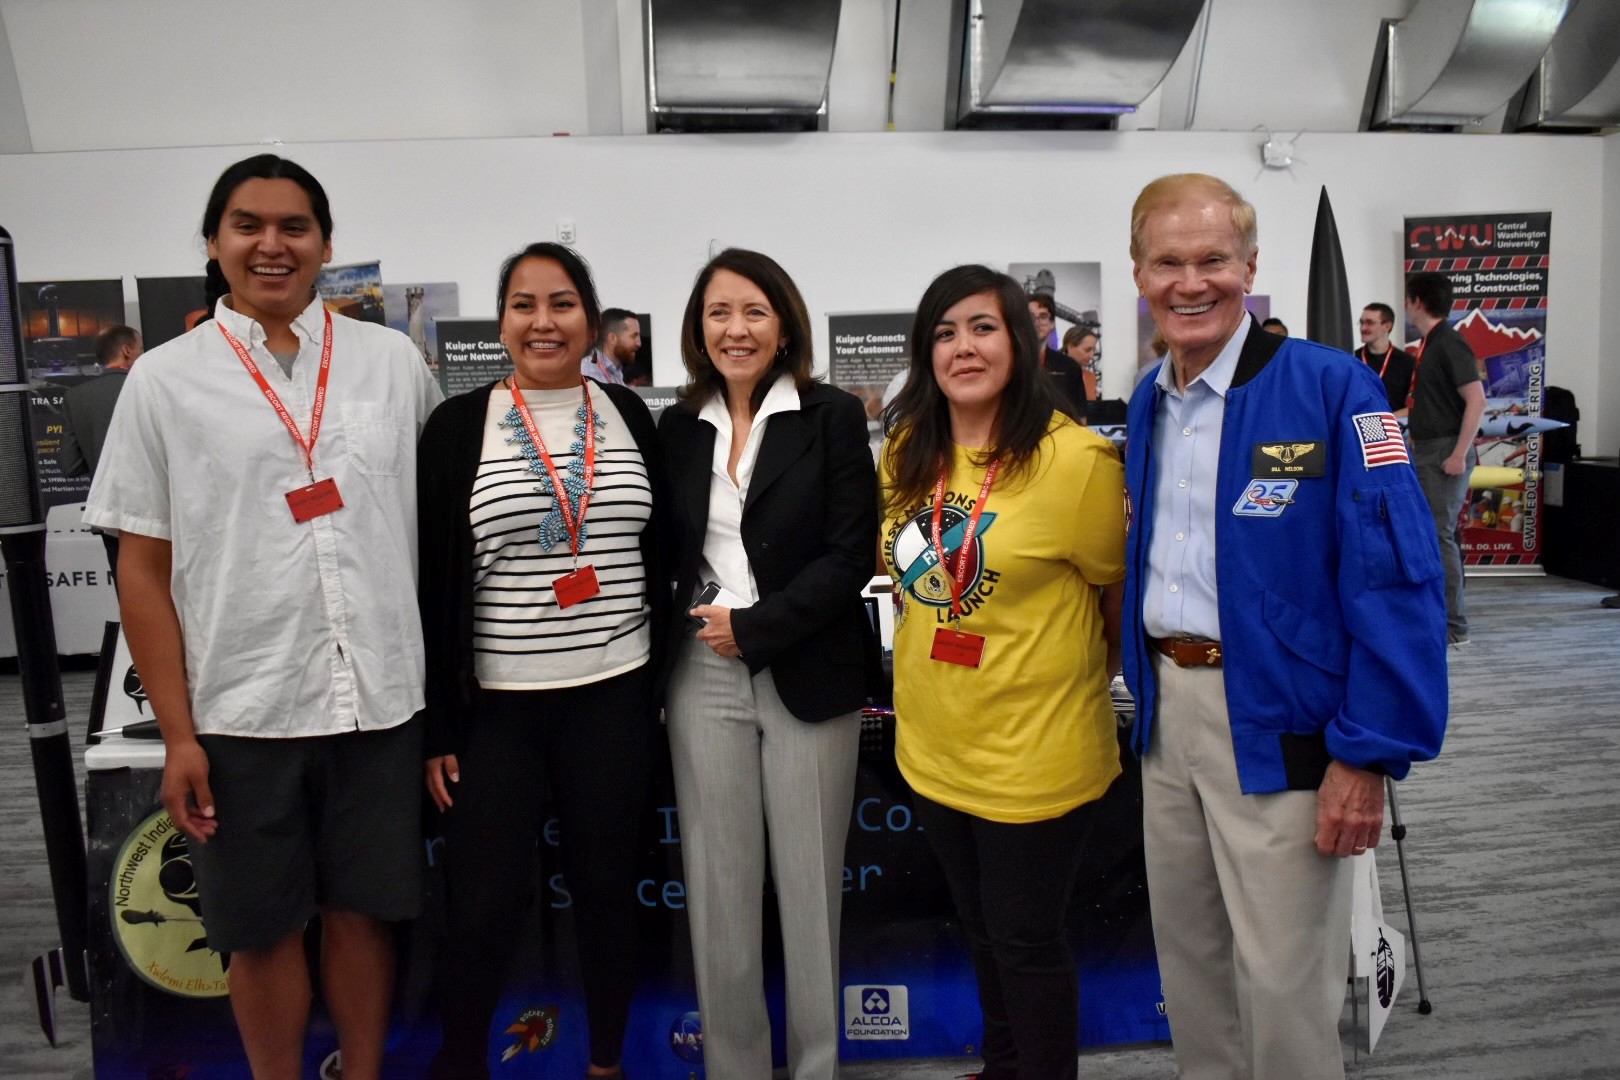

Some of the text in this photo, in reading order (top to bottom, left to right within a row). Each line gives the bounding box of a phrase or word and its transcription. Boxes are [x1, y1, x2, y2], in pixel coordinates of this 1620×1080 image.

[1497, 222, 1527, 231] Central
[1497, 231, 1547, 241] Washington
[1410, 224, 1493, 251] CWU
[1497, 240, 1540, 249] University
[1474, 272, 1543, 282] Technologies,
[1474, 283, 1539, 292] Construction
[445, 341, 475, 351] Kuiper
[836, 334, 906, 344] Kuiper Connects
[224, 330, 257, 374] ESCORT REQUIRED
[321, 344, 331, 369] ESCORT
[446, 353, 467, 361] Your
[836, 345, 903, 354] Your Customers
[643, 397, 676, 408] mazon
[264, 389, 301, 440] ESCORT REQUIRED
[311, 386, 325, 440] ESCORT REQUIRED
[520, 404, 546, 454] ESCORT REQUIRED
[551, 470, 567, 500] REQUIRED
[980, 473, 993, 499] ESCORT
[904, 491, 977, 519] NATONS
[1241, 484, 1288, 511] 25
[578, 496, 588, 525] EQUIRED
[957, 519, 977, 583] ESCORT REQUIRED
[46, 571, 97, 587] SAFE
[115, 839, 152, 907] Northwest
[520, 1010, 545, 1022] ROCKET
[852, 1016, 902, 1026] ALCOA
